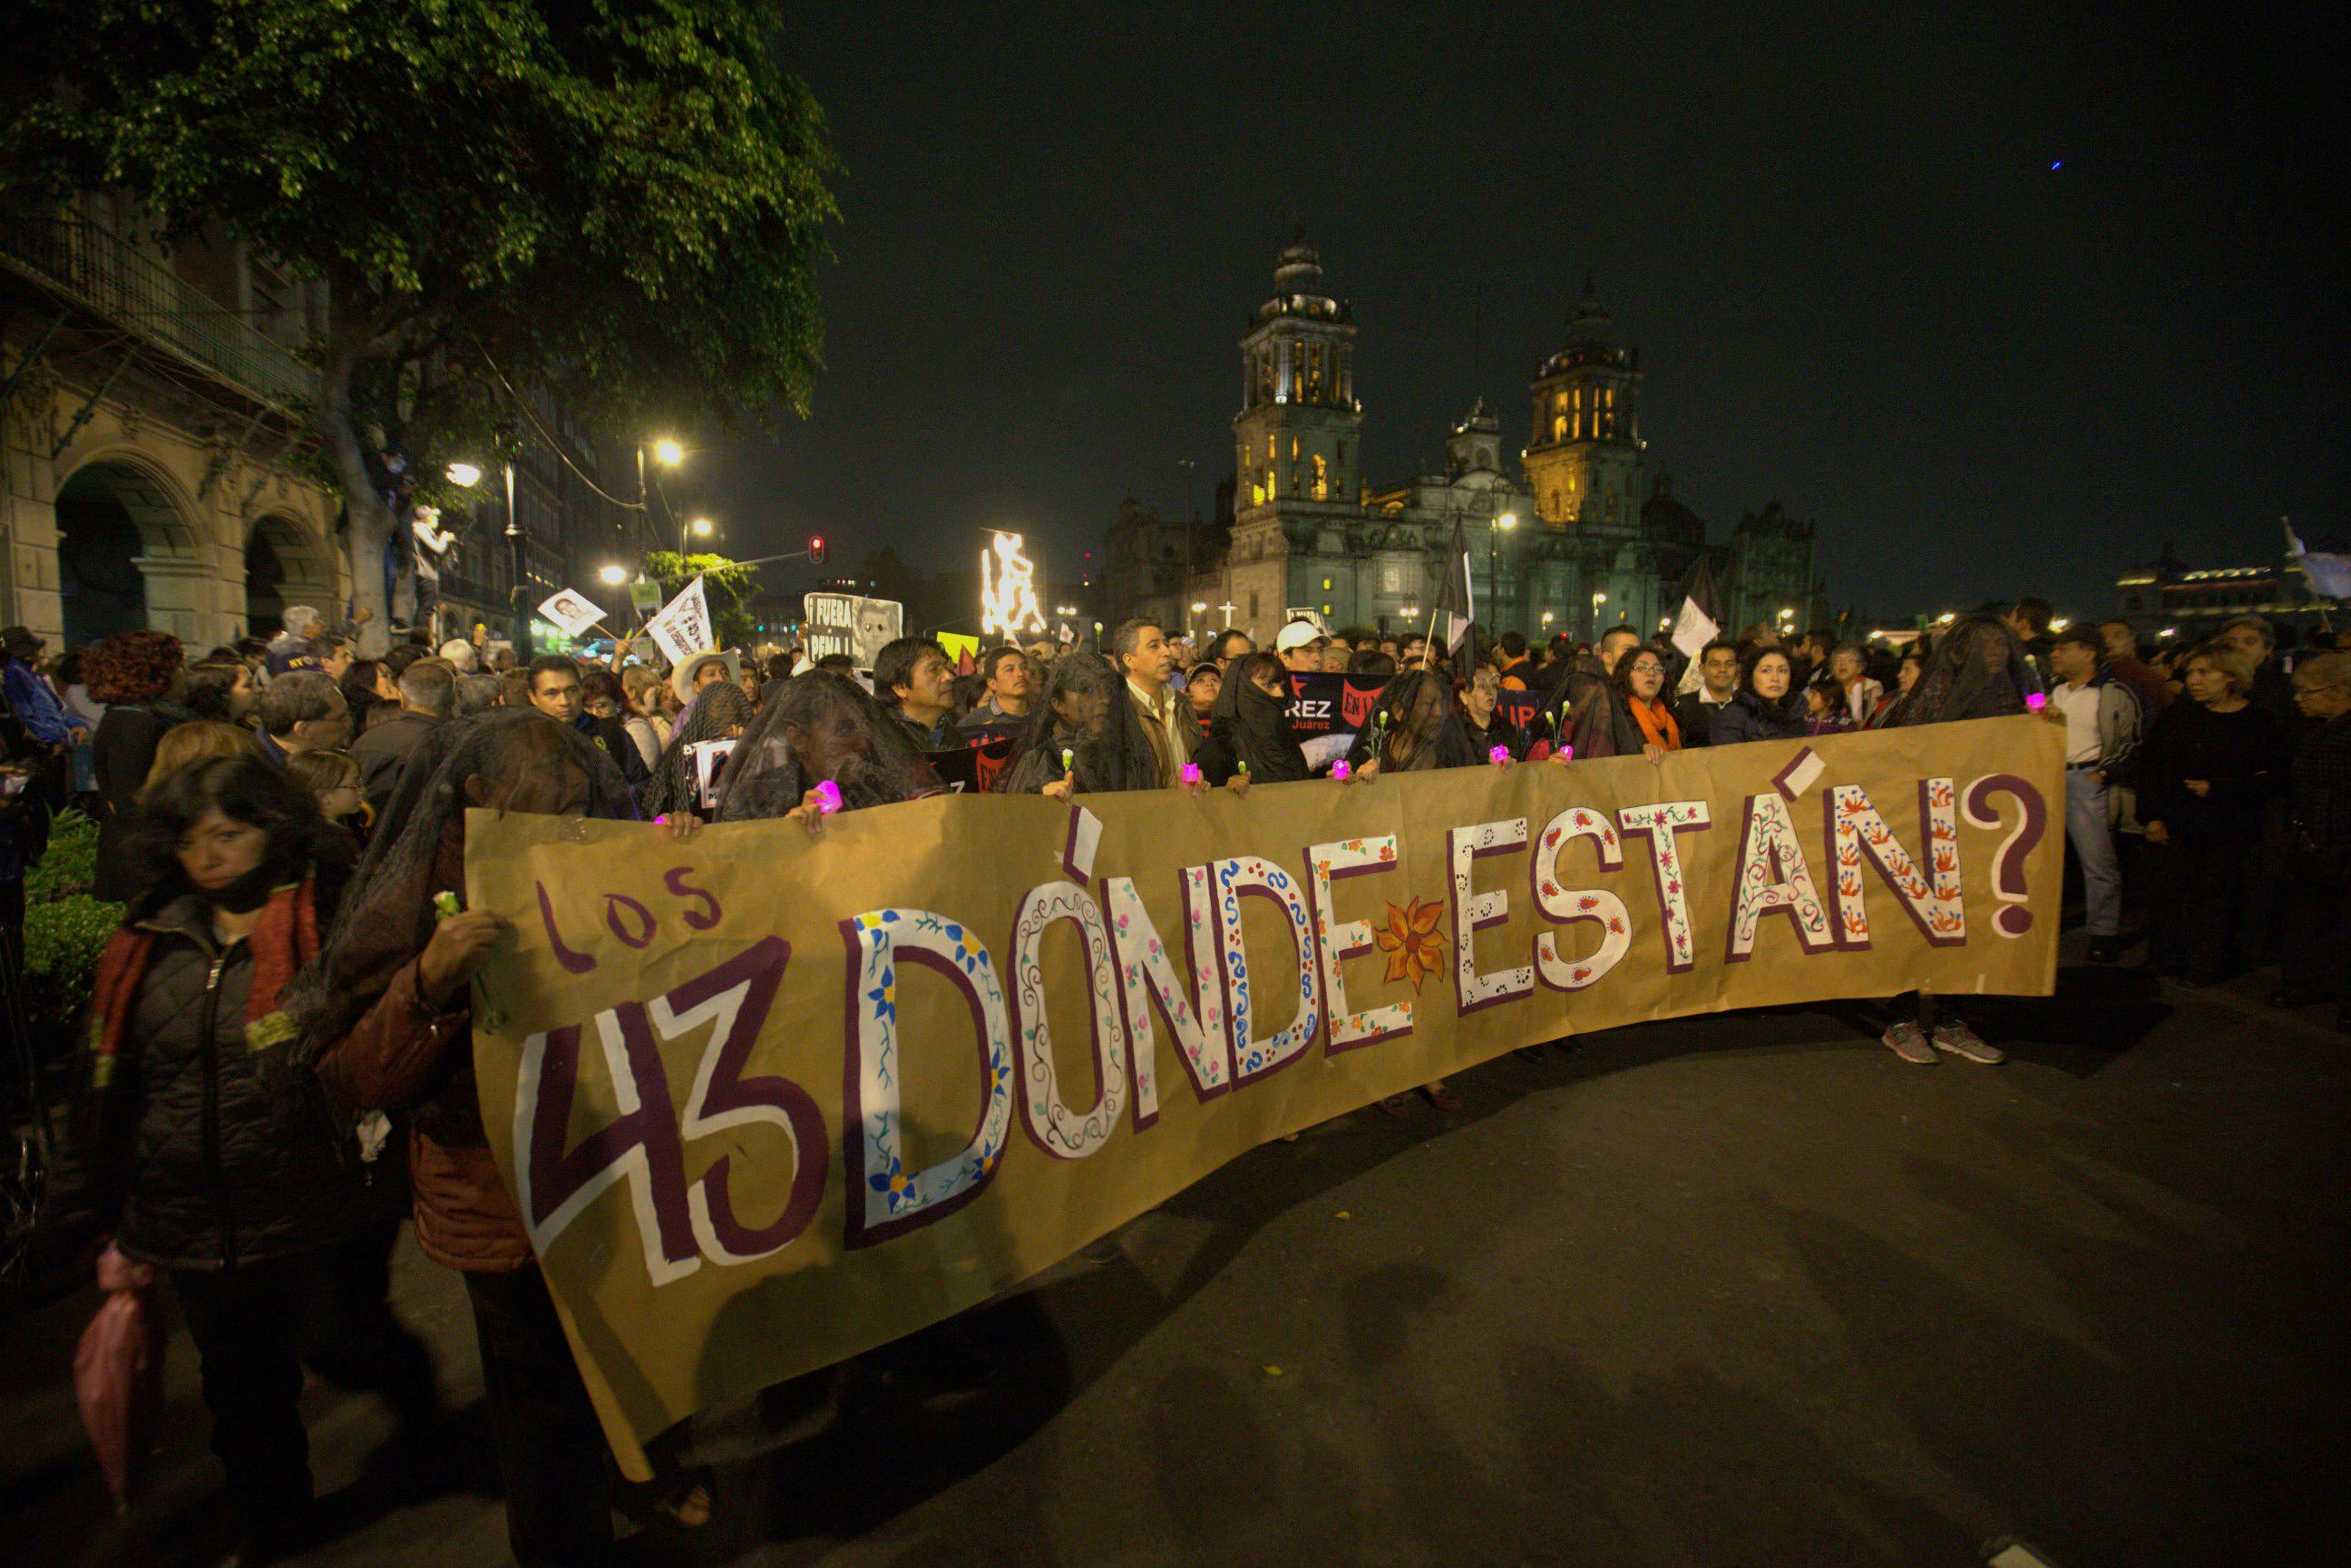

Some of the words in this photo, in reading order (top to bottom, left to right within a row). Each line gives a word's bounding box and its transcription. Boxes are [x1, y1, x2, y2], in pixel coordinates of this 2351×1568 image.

[1292, 718, 1331, 730] Juárez
[512, 934, 830, 1288] 43
[837, 804, 1413, 1251] DÓNDE
[1446, 745, 2048, 1016] ESTÁN?
